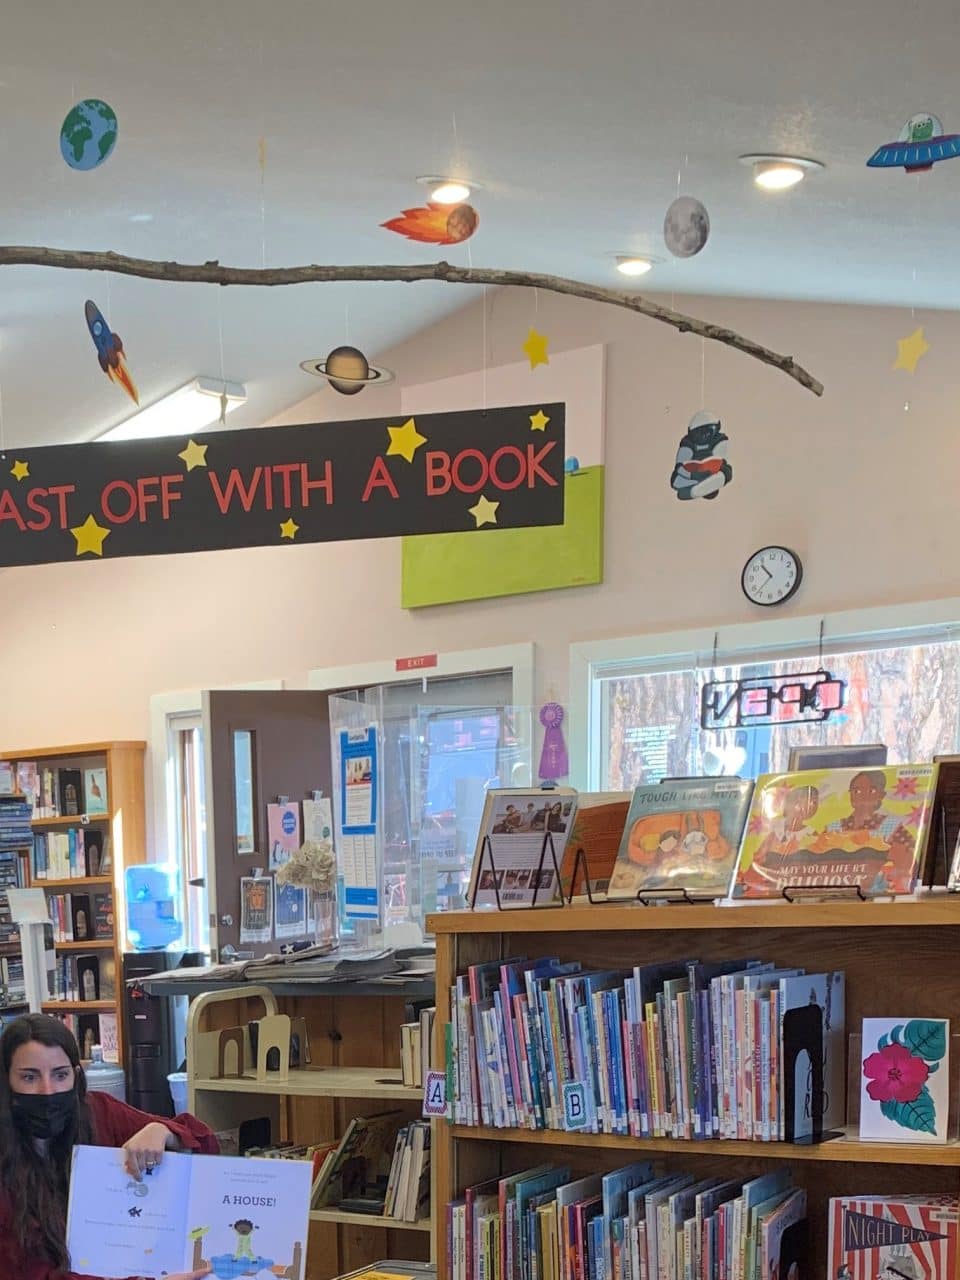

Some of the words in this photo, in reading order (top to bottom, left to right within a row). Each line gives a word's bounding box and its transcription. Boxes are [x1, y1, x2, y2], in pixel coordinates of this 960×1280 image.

[101, 475, 183, 525] OFF
[209, 462, 333, 514] WITH
[362, 456, 400, 501] A
[425, 441, 557, 496] BOOK
[407, 657, 425, 667] EXIT
[640, 791, 677, 802] TOUGH
[802, 864, 828, 874] YOUR
[831, 864, 851, 874] LIFE
[432, 1082, 443, 1103] A
[570, 1094, 581, 1116] B
[222, 1195, 231, 1205] A
[233, 1195, 276, 1207] HOUSE!
[848, 1216, 894, 1246] NIGHT
[902, 1227, 932, 1241] PLAY
